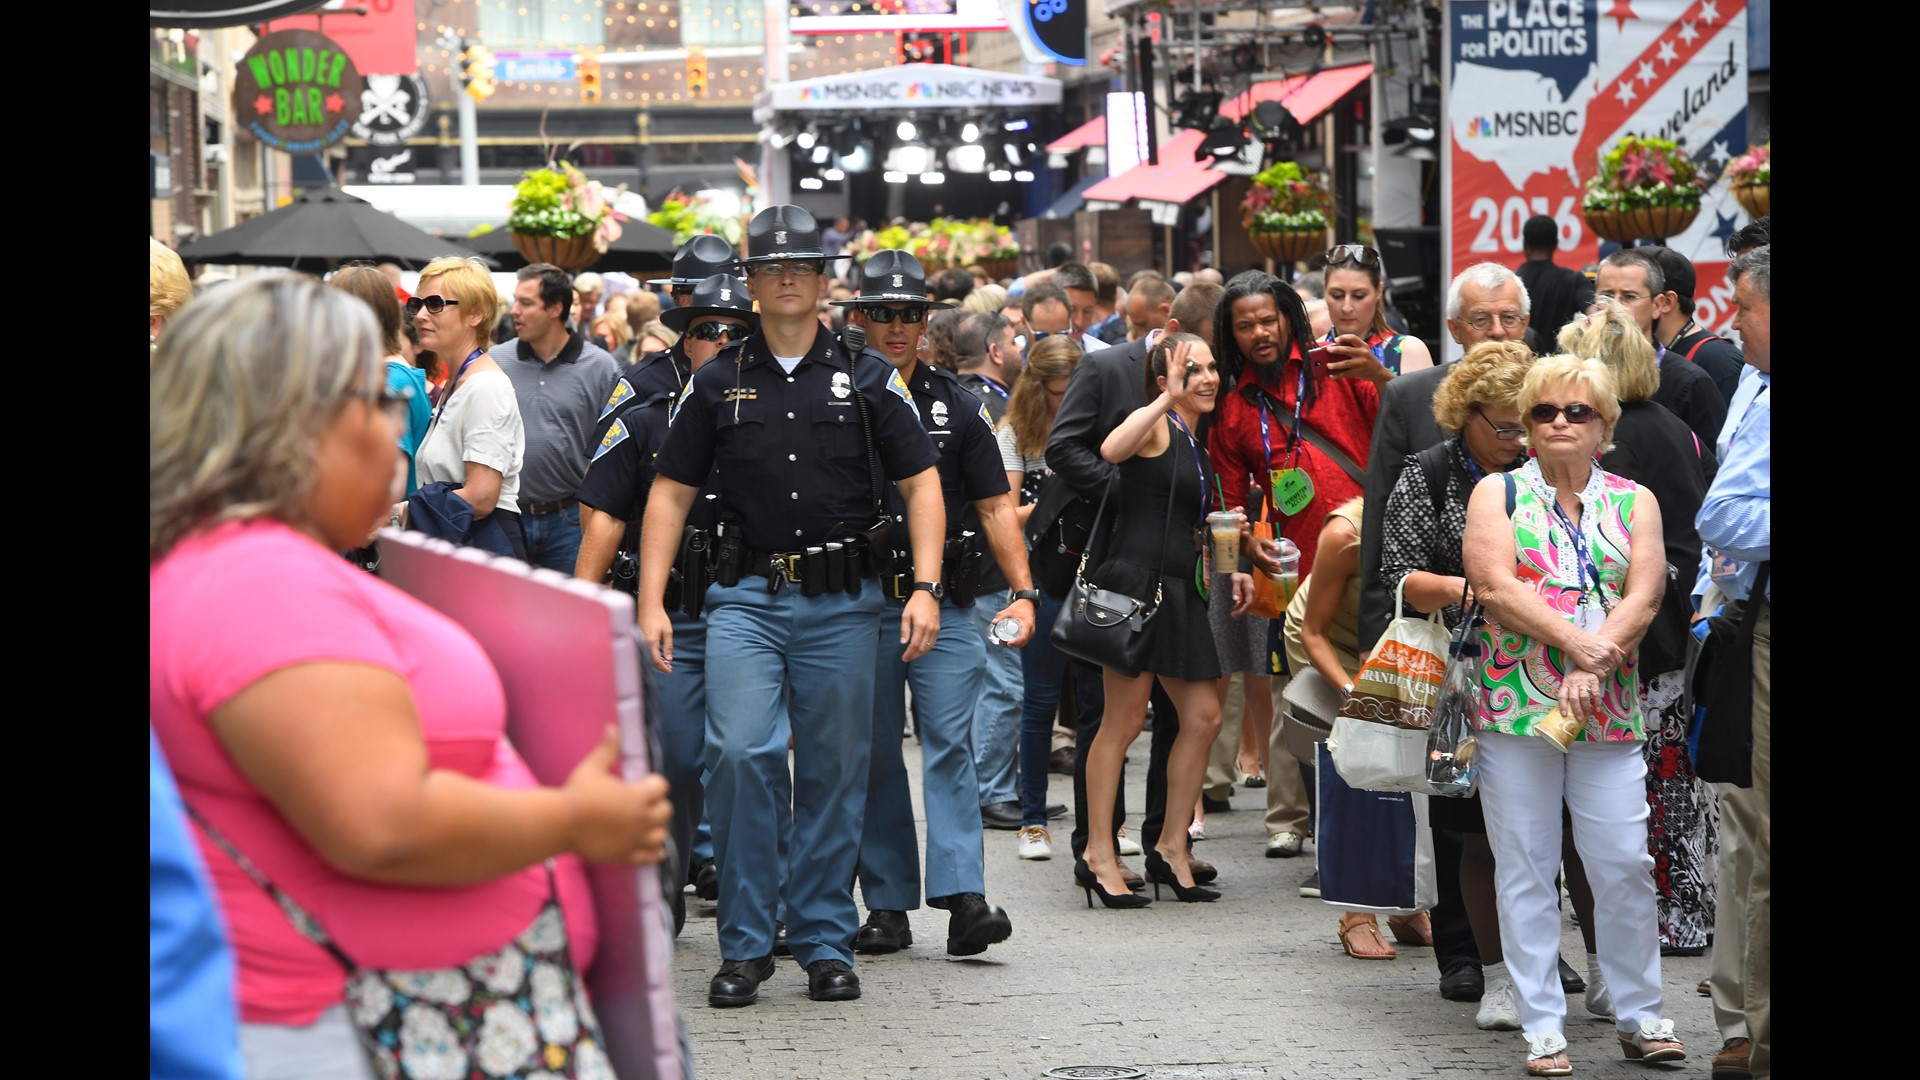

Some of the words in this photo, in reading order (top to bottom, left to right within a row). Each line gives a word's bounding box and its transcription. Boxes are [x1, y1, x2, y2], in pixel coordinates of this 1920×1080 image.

[1460, 14, 1484, 29] THE
[1488, 0, 1585, 28] PLACE
[1461, 43, 1486, 57] FOR
[1488, 28, 1588, 57] POLITICS
[247, 47, 347, 90] WONDER
[823, 82, 900, 100] MSNBC
[936, 80, 977, 99] NBC
[981, 79, 1037, 99] NEWS
[275, 86, 324, 127] BAR
[1494, 111, 1578, 138] MSNBC
